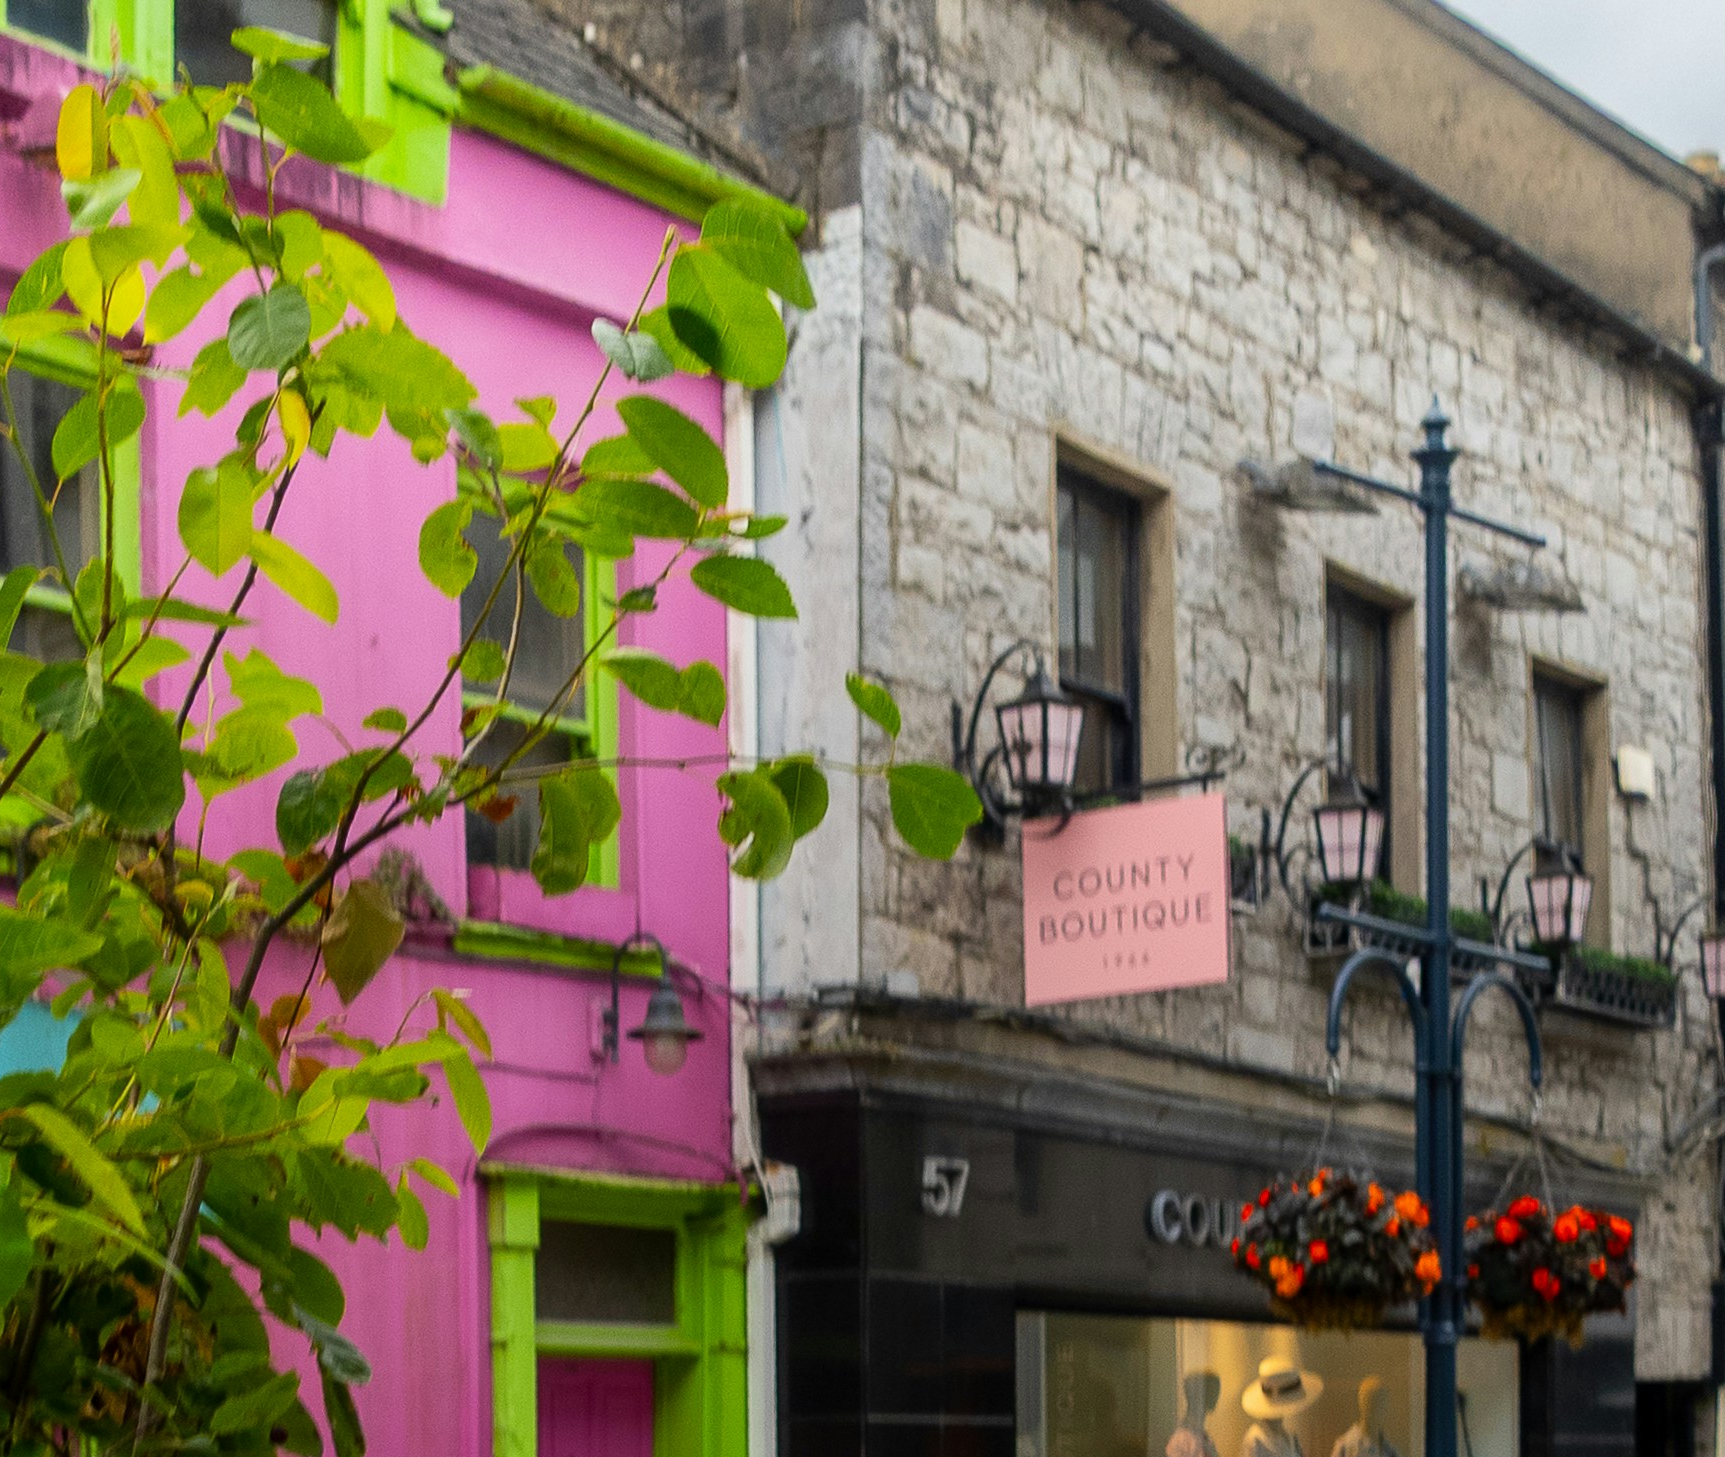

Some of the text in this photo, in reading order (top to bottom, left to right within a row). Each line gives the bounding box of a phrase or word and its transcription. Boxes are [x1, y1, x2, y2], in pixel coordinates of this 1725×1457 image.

[1053, 852, 1194, 900] COUNTY
[1039, 892, 1213, 946] BOUTIQUE
[921, 1154, 971, 1218] 57
